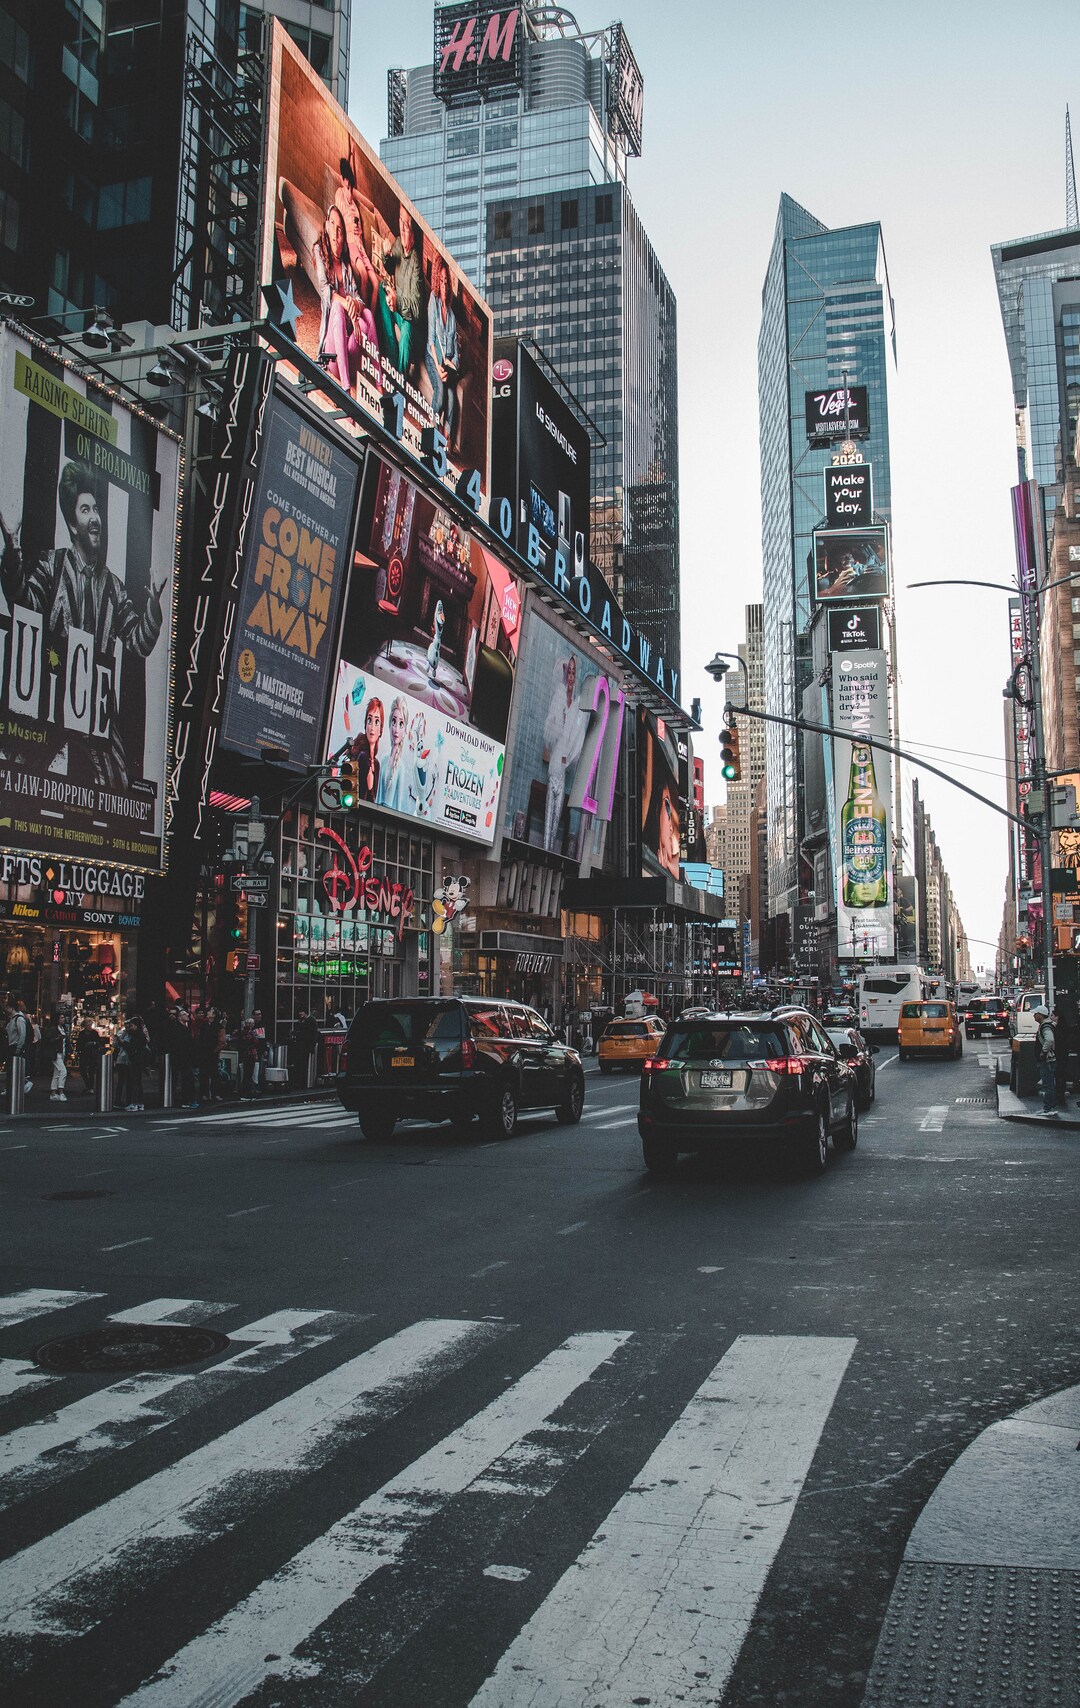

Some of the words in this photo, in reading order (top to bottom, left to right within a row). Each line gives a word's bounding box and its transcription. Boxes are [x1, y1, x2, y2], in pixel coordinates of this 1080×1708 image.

[439, 9, 520, 73] H&M
[361, 355, 380, 384] plan
[382, 374, 395, 394] for
[361, 332, 380, 363] Talk
[381, 356, 405, 388] about
[405, 382, 434, 420] making
[434, 413, 440, 424] a
[24, 365, 69, 414] RAISING
[72, 397, 110, 441] SPIRITS
[359, 384, 380, 414] Then
[493, 385, 512, 399] LG
[536, 402, 545, 423] LG
[300, 425, 333, 468] WINNER!
[832, 453, 863, 466] 2020
[76, 433, 91, 460] ON
[94, 442, 151, 496] BROADWAY!
[285, 440, 306, 475] BEST
[305, 454, 337, 497] MUSICAL
[831, 474, 865, 486] Make
[834, 488, 862, 502] your
[836, 502, 862, 515] day.
[266, 490, 290, 512] COME
[291, 505, 329, 538] TOGETHER
[329, 534, 340, 546] AT
[262, 507, 336, 584] COME
[254, 544, 331, 623] FROM
[505, 594, 517, 610] NEW
[527, 522, 678, 699] BROADWAY
[246, 590, 327, 660] AWAY
[842, 630, 866, 638] TikTok
[244, 629, 256, 641] THE
[256, 635, 290, 658] REMARKABLE
[291, 652, 305, 665] TRUE
[305, 659, 320, 673] STORY
[853, 661, 878, 670] Spotify
[838, 674, 859, 682] Who
[860, 673, 878, 681] said
[838, 684, 875, 692] January
[839, 693, 854, 701] has
[868, 692, 878, 700] be
[839, 702, 860, 712] dry?
[445, 721, 479, 748] DOWNLOAD
[479, 740, 496, 756] NOW!
[14, 772, 95, 809] JAW-DROPPING
[445, 760, 485, 797] FROZEN
[14, 820, 28, 832] THIS
[29, 823, 42, 835] WAY
[44, 826, 52, 836] TO
[53, 827, 64, 839] THE
[64, 829, 104, 846] NETHERWORLD
[112, 838, 126, 850] 50TH
[131, 842, 158, 856] BROADWAY
[687, 811, 696, 844] 1500
[844, 845, 884, 855] Heineken
[0, 854, 42, 886] FTS
[58, 863, 145, 899] LUGGAGE
[12, 904, 40, 918] Nikon
[45, 908, 77, 921] Canon
[83, 911, 115, 924] SONY
[514, 953, 545, 973] FOREVER
